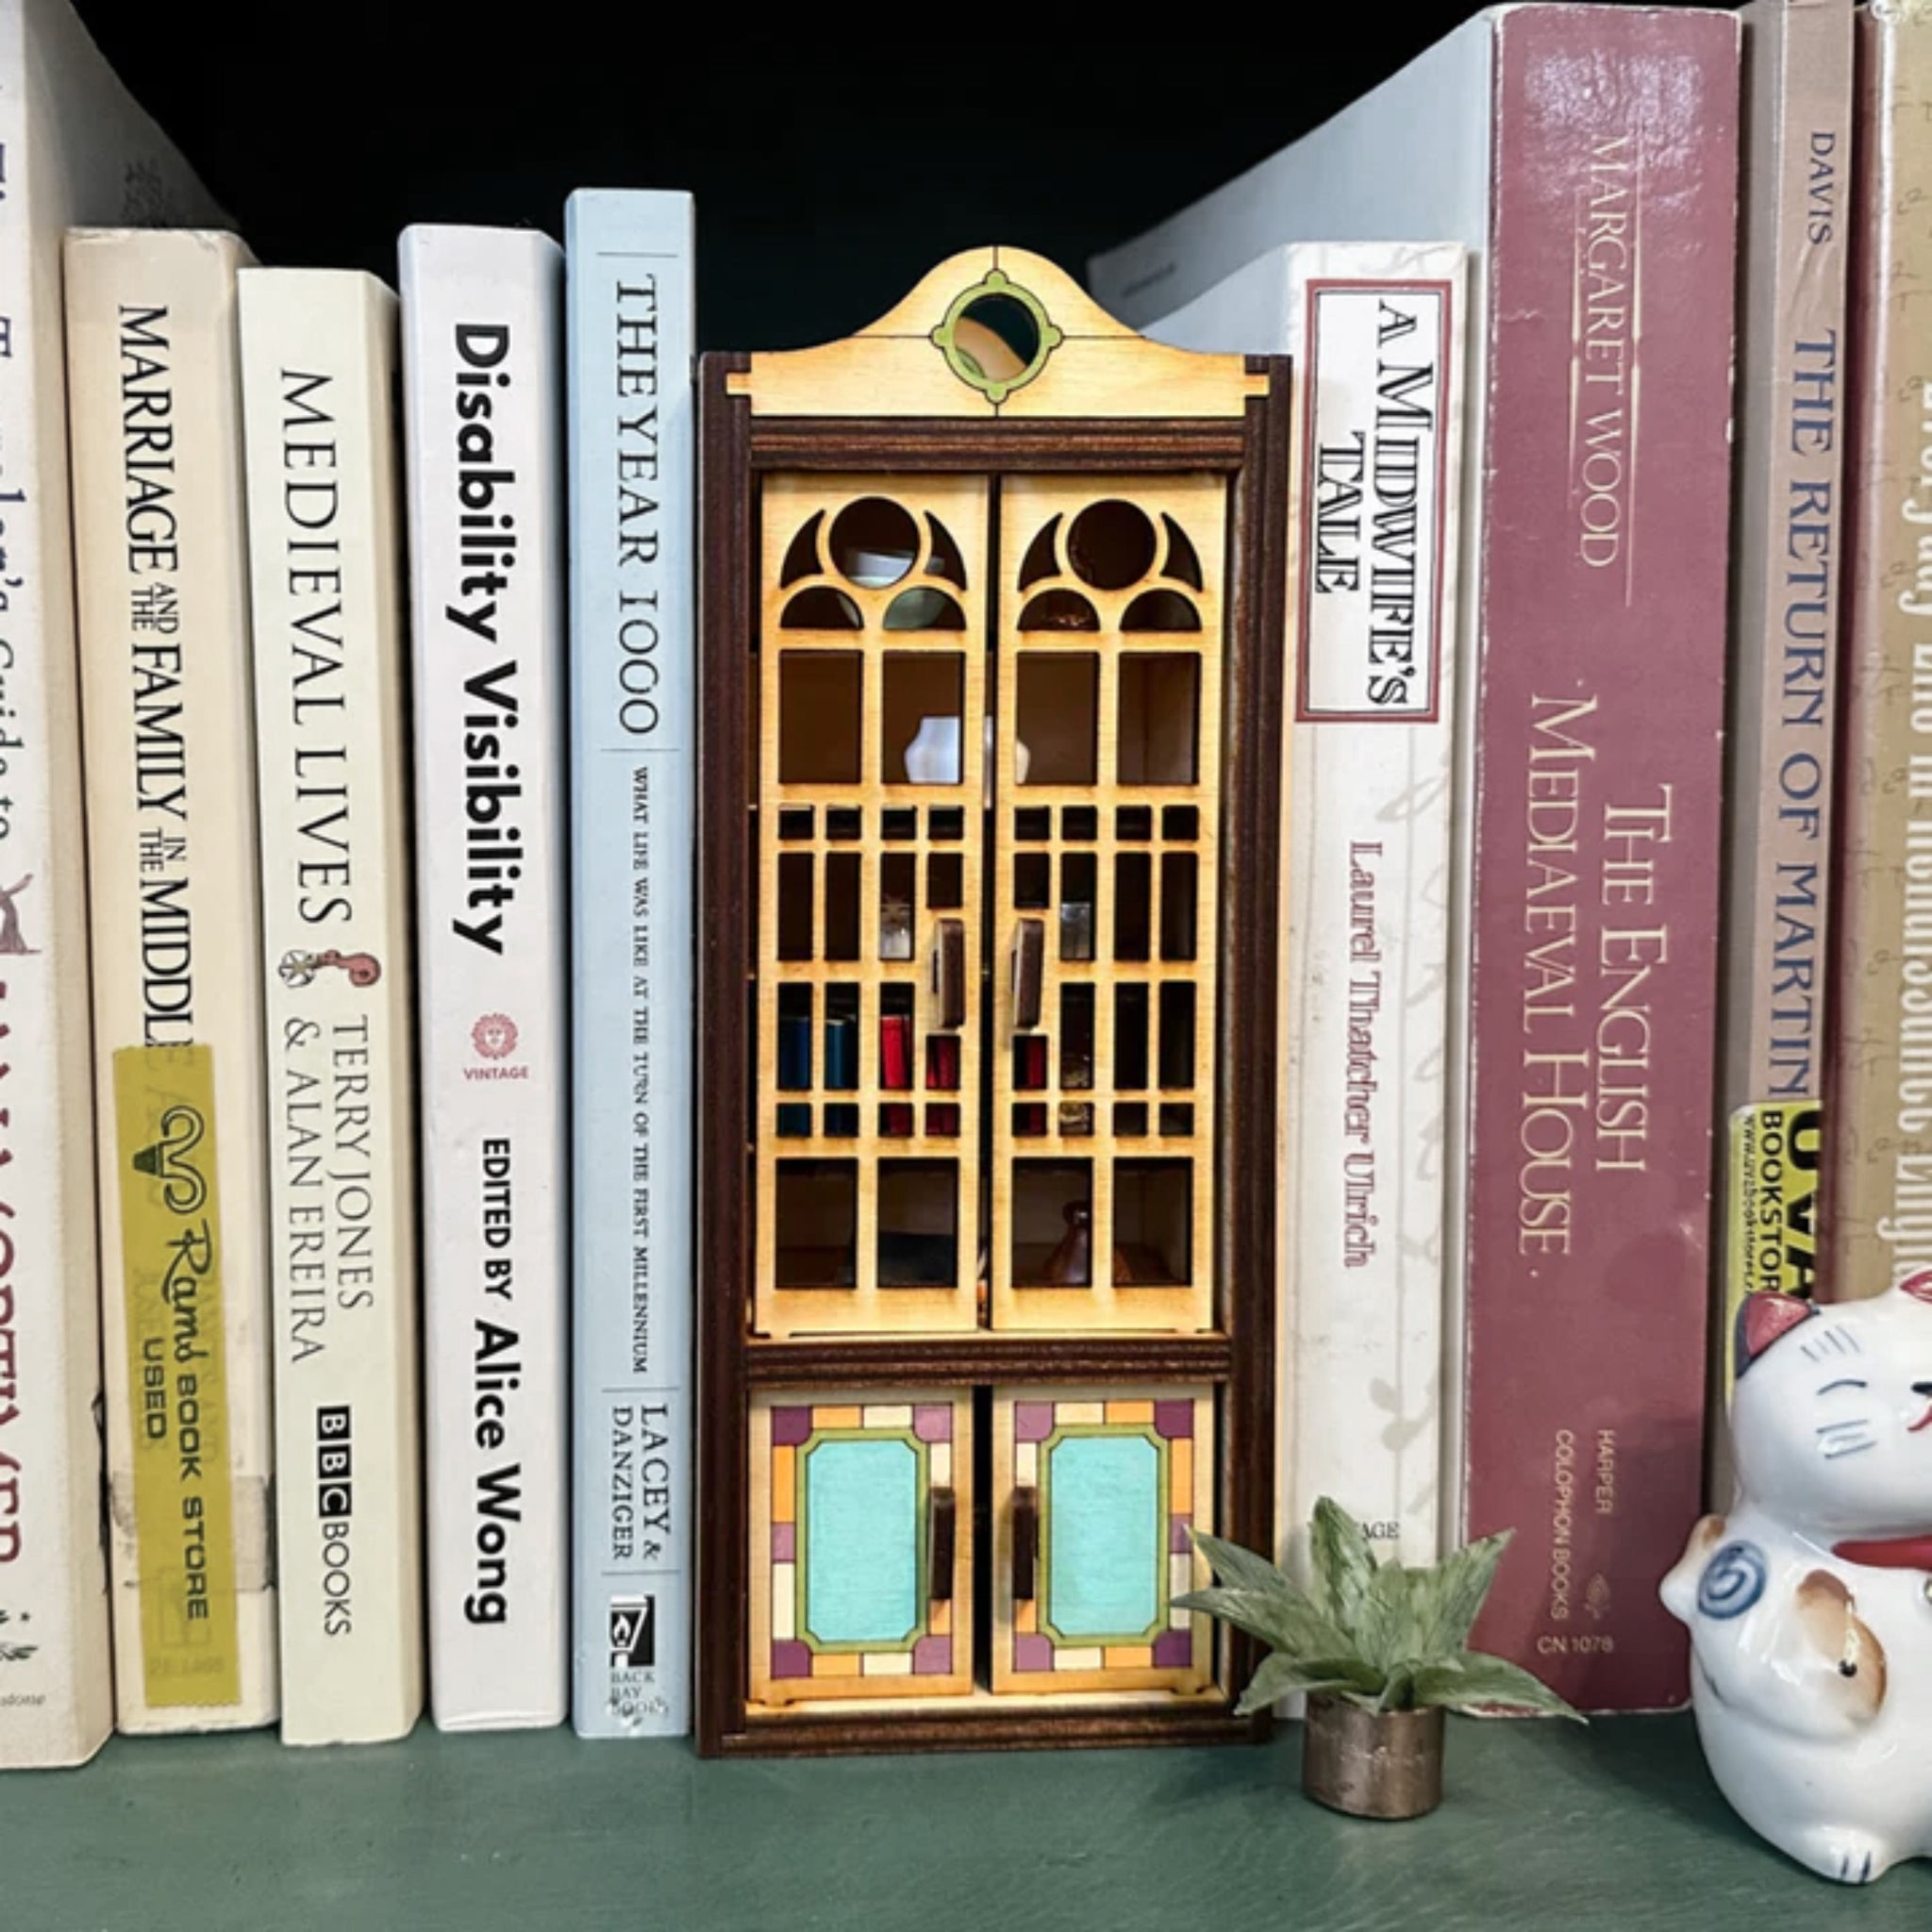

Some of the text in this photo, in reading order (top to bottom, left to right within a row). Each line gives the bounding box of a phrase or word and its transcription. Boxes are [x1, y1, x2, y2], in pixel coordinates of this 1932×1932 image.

[1808, 132, 1835, 245] DAVIS
[616, 273, 658, 397] THE
[1580, 134, 1630, 567] MARGARET WOOD
[118, 304, 179, 575] MARRIAGE
[617, 405, 659, 567] YEAR
[1315, 430, 1366, 593] TALE
[1368, 298, 1434, 705] A MIDWIFE'S
[131, 589, 155, 631] THE
[154, 581, 180, 634] AND
[280, 367, 353, 924] MEDIEVAL LIVES
[445, 325, 524, 956] Disability Visibility
[131, 642, 188, 821] FAMILY
[1768, 328, 1836, 1095] THE RETURN OF MARTIN
[139, 826, 163, 873] THE
[163, 836, 187, 862] IN
[1343, 840, 1383, 1269] Laurel Thatcher Ulrich
[1518, 693, 1597, 1256] MEDIAEVAL HOUSE
[1595, 783, 1673, 1172] THE ENGLISH
[463, 1066, 529, 1080] VINTAGE
[633, 766, 649, 1374] WHAT LIFE WAS LIKE AT THE TURN OF THE FIRST MILLENNIUM
[284, 1017, 325, 1363] & ALAN EREIRA
[326, 1013, 375, 1310] TERRY JONES
[1760, 1110, 1784, 1292] BOOKSTOR
[142, 1336, 168, 1440] USED
[176, 1374, 202, 1482] BOOK
[464, 1139, 522, 1624] EDITED BY Alice Wong
[317, 1405, 352, 1636] BBC BOOKS
[612, 1406, 633, 1559] DANZIGER
[641, 1404, 671, 1560] LACEY &
[1550, 1429, 1574, 1620] COLOPHON BOOKS
[1595, 1429, 1614, 1513] HARPER
[181, 1495, 208, 1621] STORE
[610, 1671, 656, 1684] BACK
[610, 1687, 642, 1699] BAY
[1537, 1636, 1567, 1654] CN
